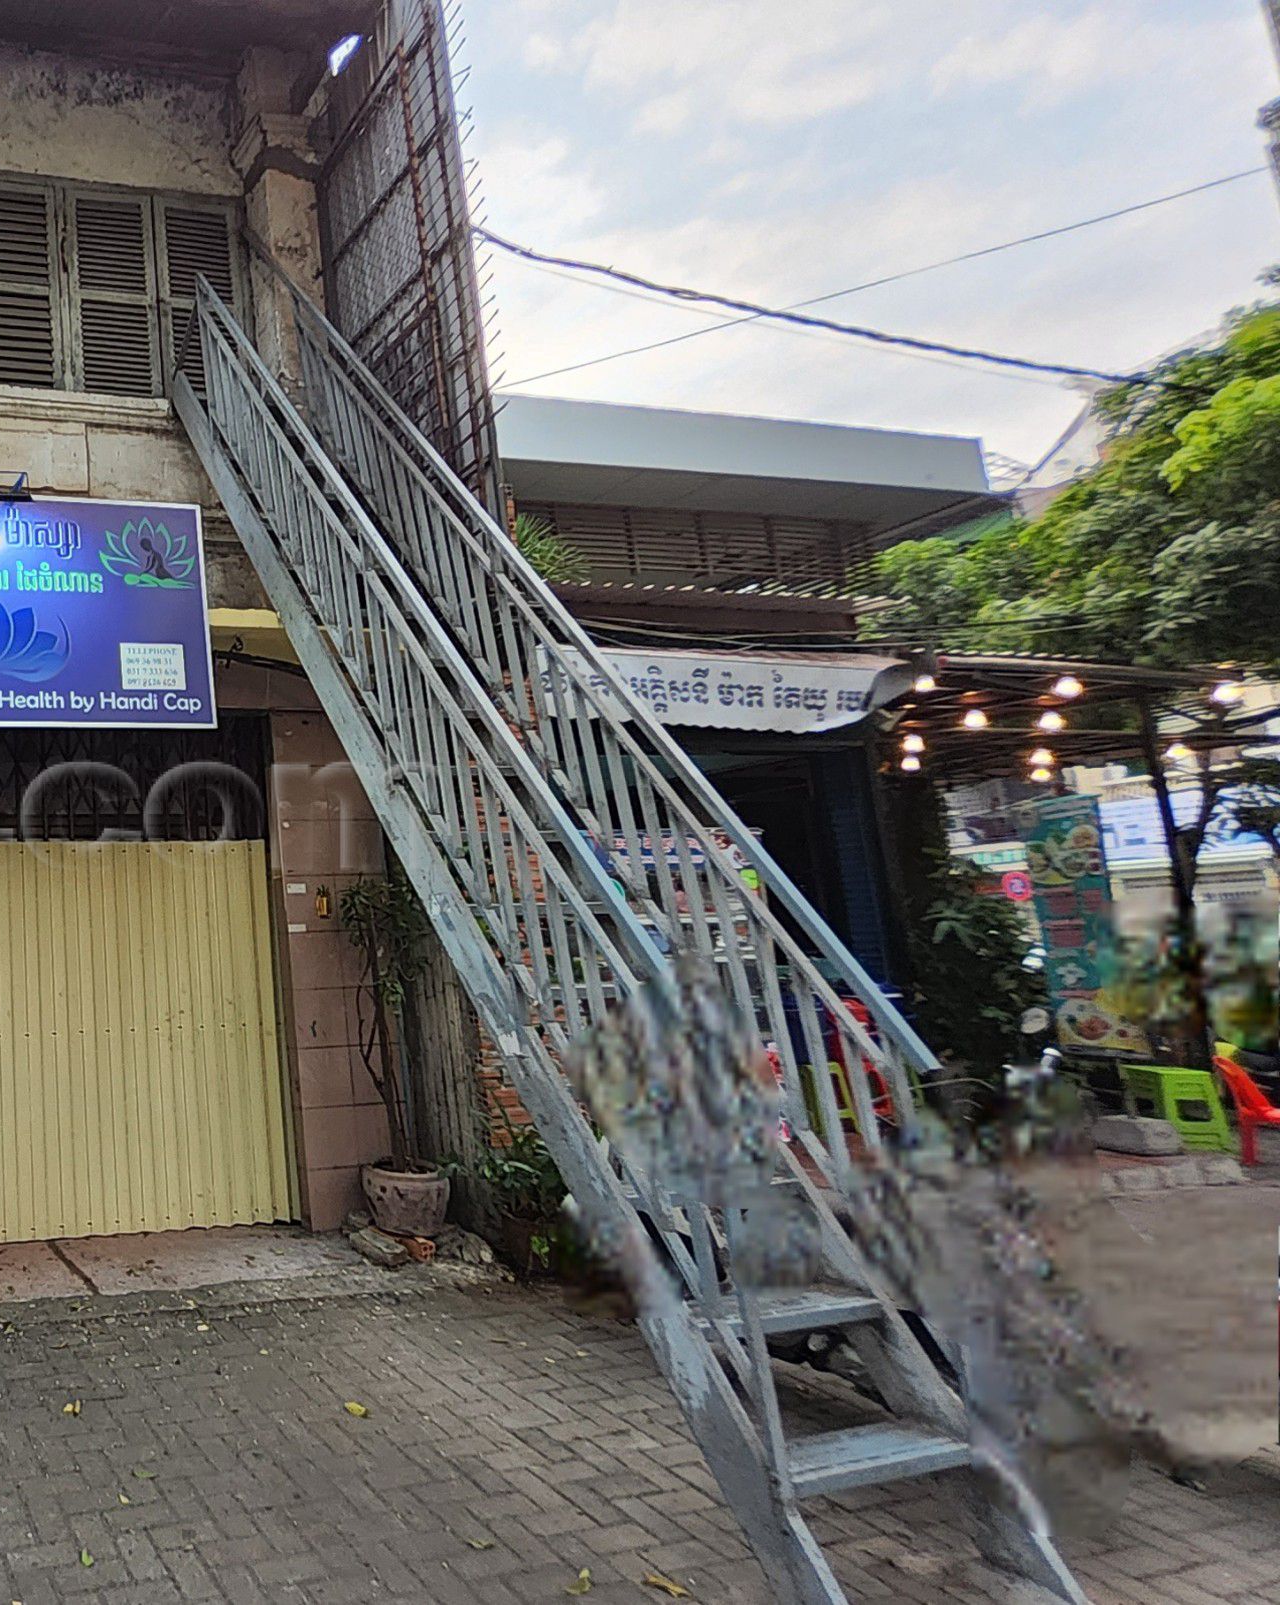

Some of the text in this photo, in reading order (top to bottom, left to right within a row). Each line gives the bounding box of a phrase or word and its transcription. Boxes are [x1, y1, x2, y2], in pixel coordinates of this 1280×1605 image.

[70, 691, 94, 712] by
[99, 691, 158, 710] Handi
[163, 692, 202, 713] Cap
